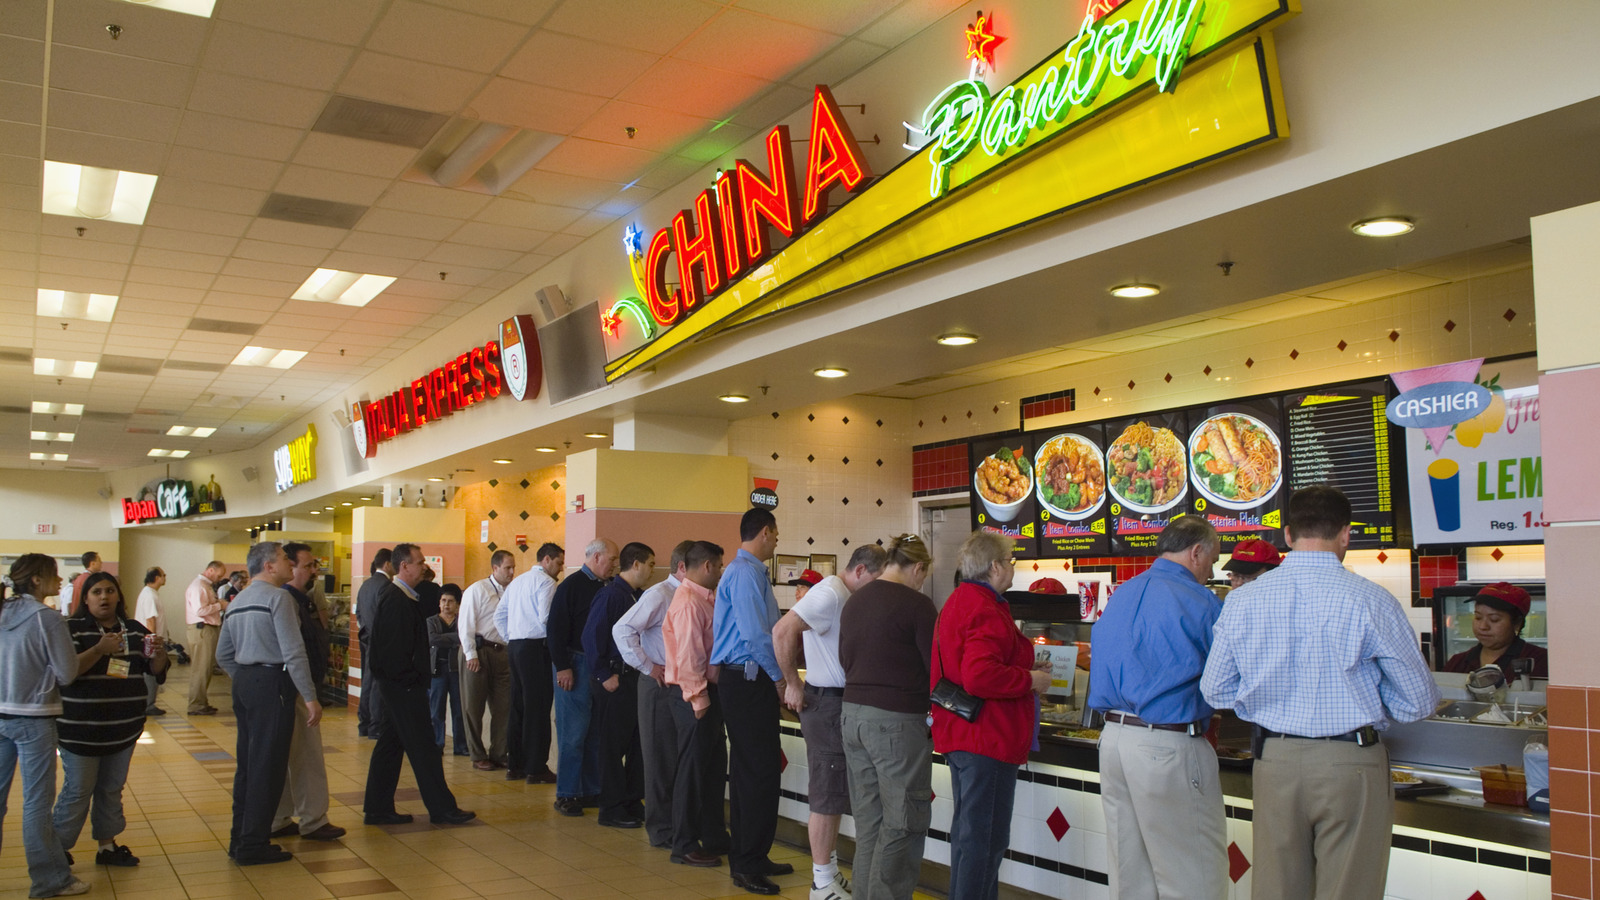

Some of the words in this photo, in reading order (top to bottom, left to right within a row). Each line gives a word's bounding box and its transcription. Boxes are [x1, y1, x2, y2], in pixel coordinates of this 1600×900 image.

[922, 0, 1202, 197] Pantry
[646, 84, 876, 325] CHINA
[366, 388, 411, 445] ITALIA
[411, 340, 501, 427] EXPRESS
[1395, 390, 1479, 418] CASHIER
[274, 430, 316, 495] SUBWAY
[752, 493, 766, 504] ORDER
[1197, 500, 1203, 509] 4
[121, 498, 158, 524] Japan
[199, 503, 214, 513] GRILL
[1113, 504, 1118, 514] 3
[1043, 511, 1048, 519] 2
[1239, 511, 1260, 526] Plate
[1262, 515, 1280, 525] 5.29
[38, 524, 51, 532] EXIT
[1042, 524, 1047, 535] 2
[1049, 523, 1064, 534] Item
[1066, 521, 1090, 534] Combo
[1112, 518, 1118, 530] 3
[1122, 516, 1138, 530] Item
[1140, 514, 1169, 529] Combo
[1490, 521, 1517, 531] Reg.
[1002, 524, 1020, 536] Bowl
[1022, 526, 1033, 534] 4.79
